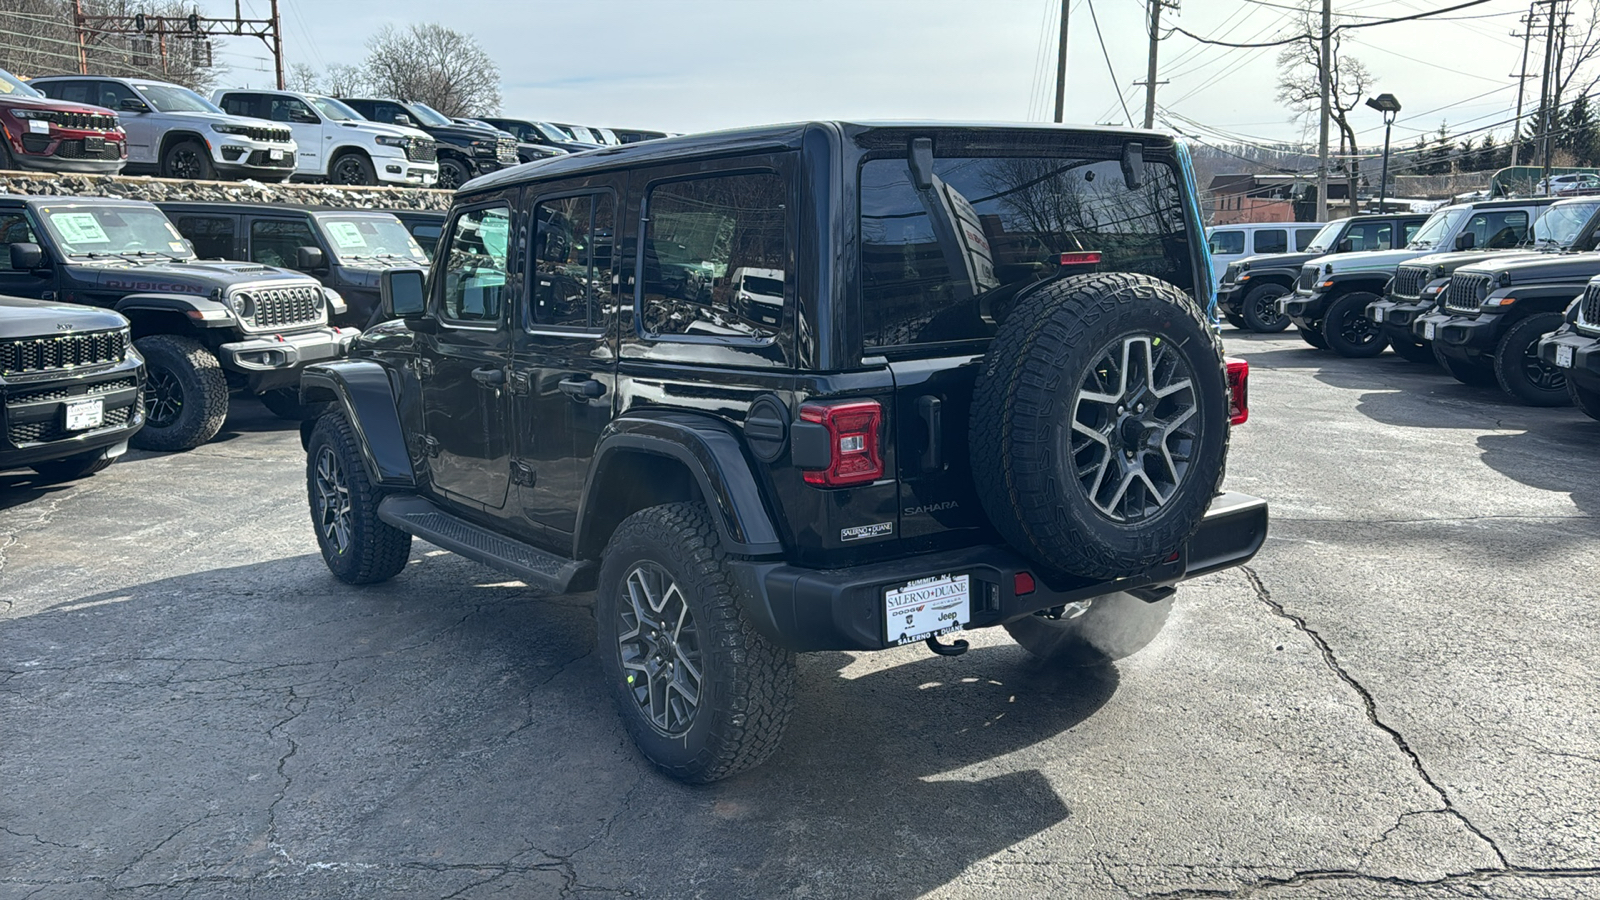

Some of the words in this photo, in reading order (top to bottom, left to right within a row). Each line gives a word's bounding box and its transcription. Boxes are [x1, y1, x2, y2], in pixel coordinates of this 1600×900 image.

[105, 280, 204, 294] RUBICON
[904, 500, 959, 516] SAHARA
[843, 526, 868, 537] SALERNO
[872, 523, 891, 532] DUANE
[887, 590, 930, 608] SALERNO
[935, 582, 967, 598] DUANE
[937, 611, 957, 622] Jeep
[897, 632, 931, 646] SALERNO
[940, 624, 964, 636] DUANE
